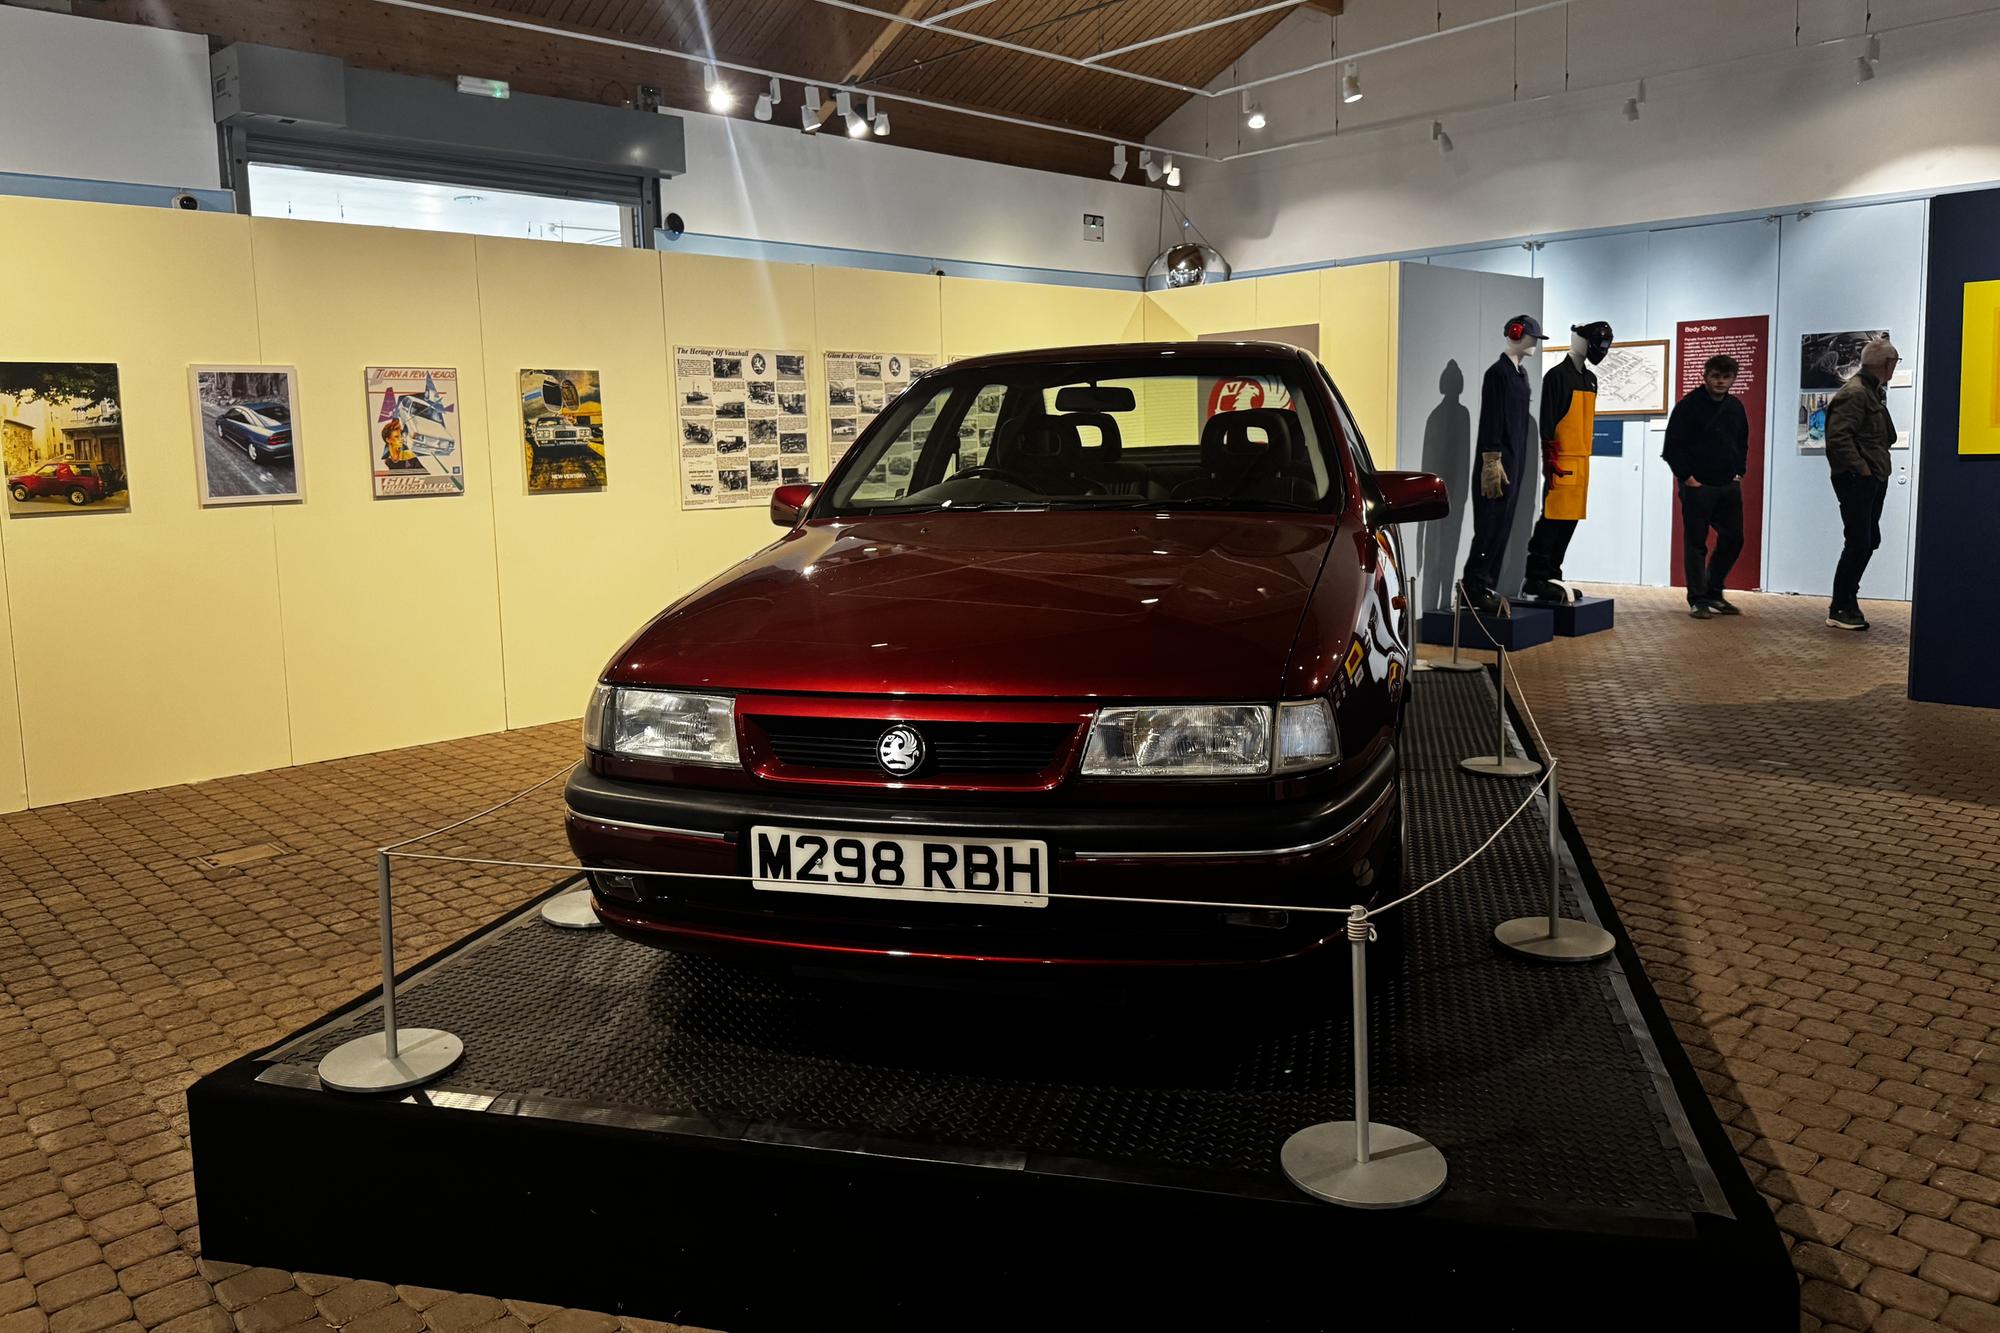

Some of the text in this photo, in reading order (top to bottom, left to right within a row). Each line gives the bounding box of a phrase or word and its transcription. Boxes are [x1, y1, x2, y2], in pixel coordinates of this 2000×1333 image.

[690, 348, 714, 356] Heritage
[716, 349, 724, 357] Of
[725, 349, 749, 357] Vauxhall
[376, 369, 455, 379] TURN A FEW HEADS
[758, 833, 1040, 896] M298 RBH
